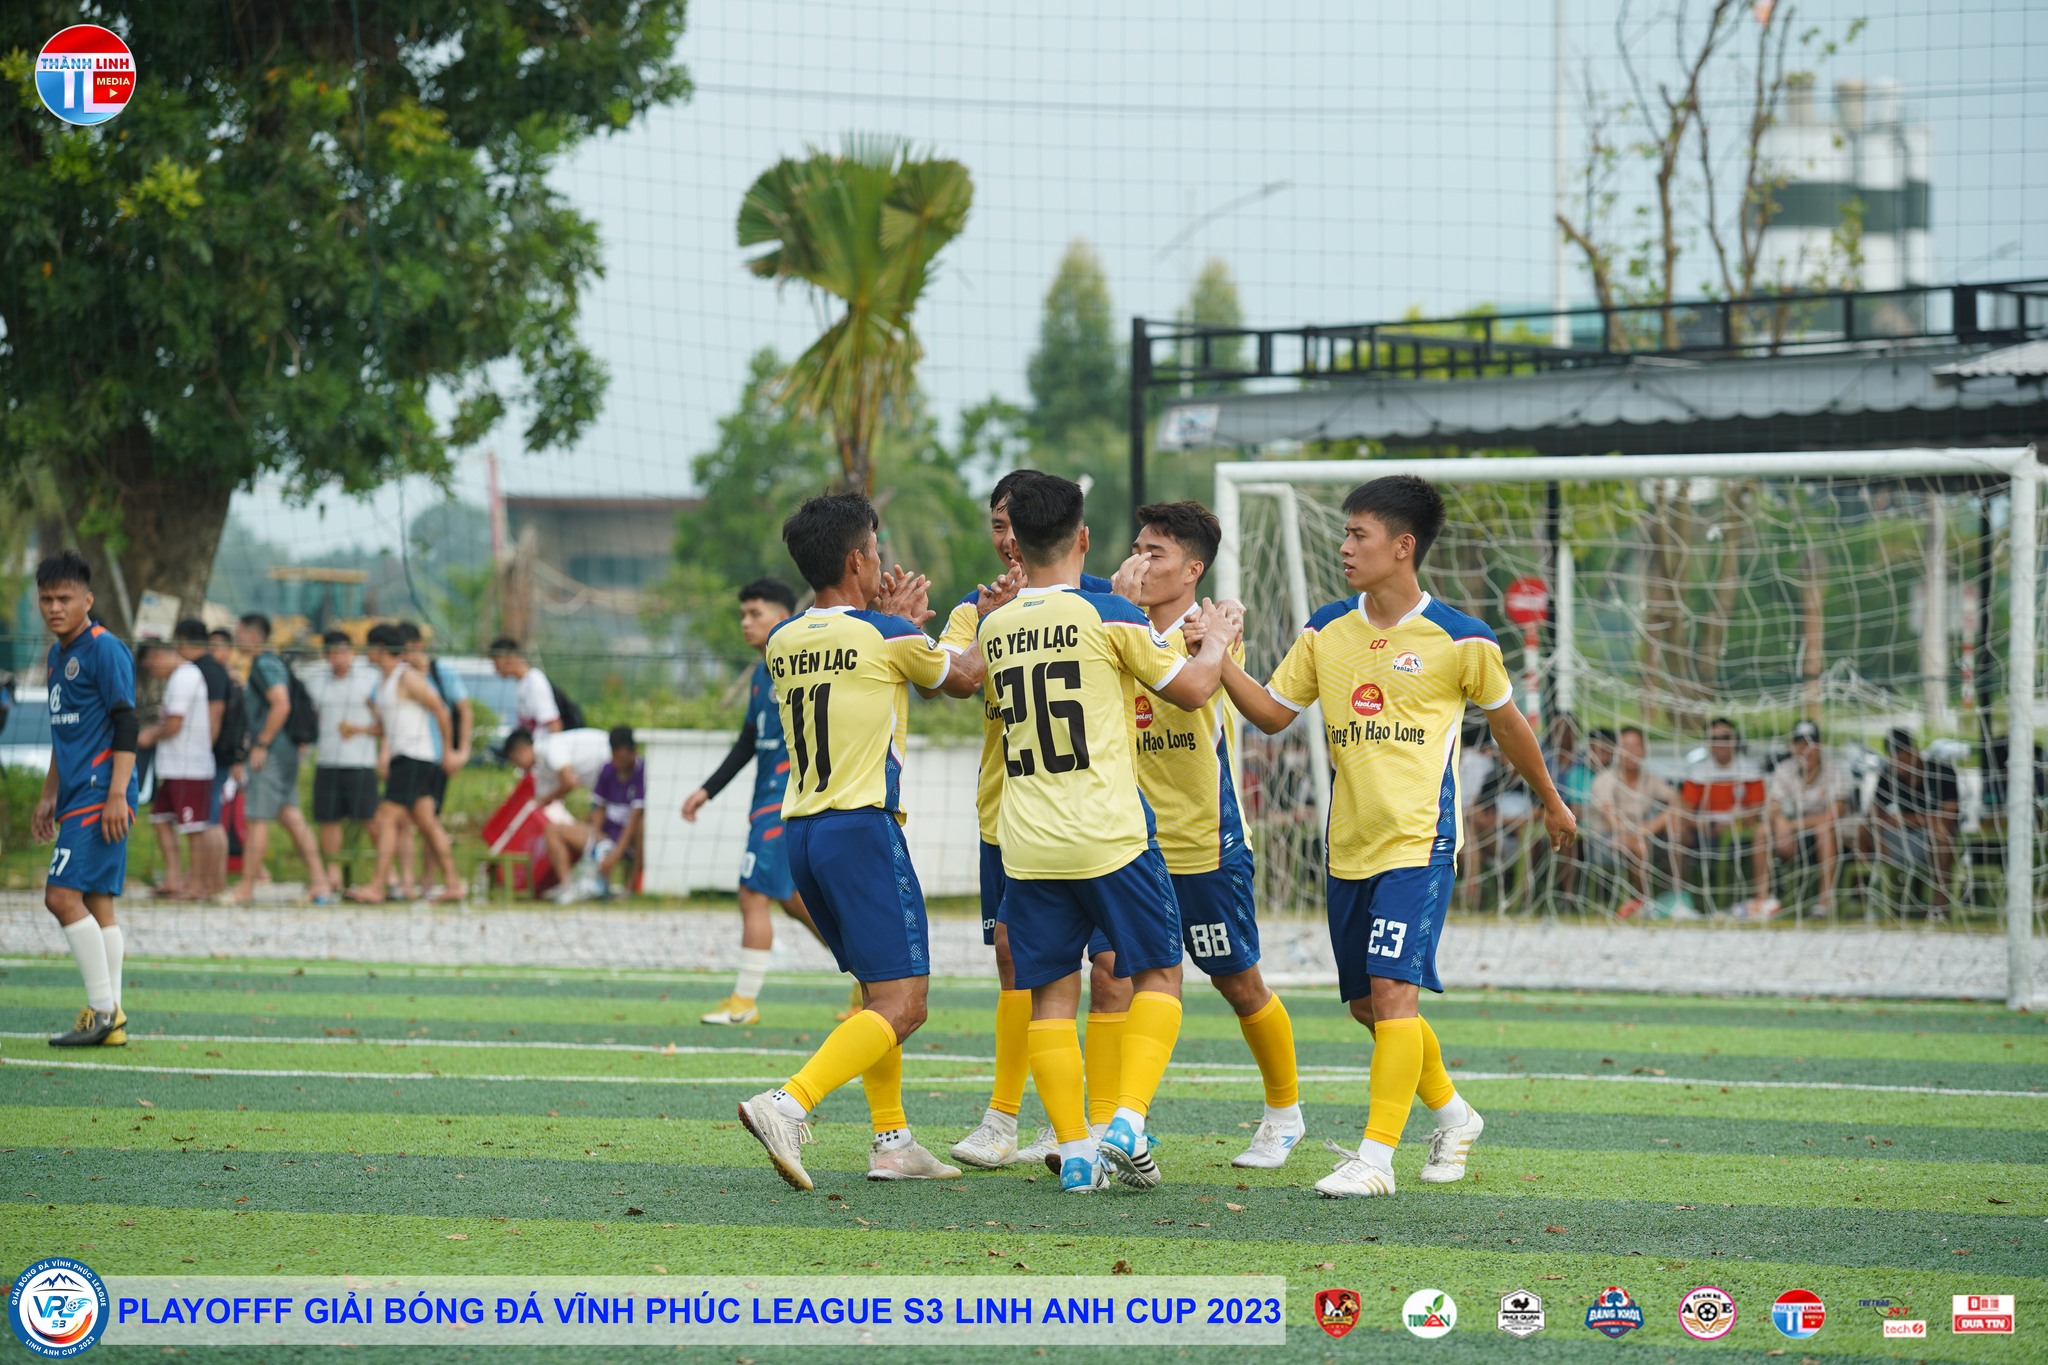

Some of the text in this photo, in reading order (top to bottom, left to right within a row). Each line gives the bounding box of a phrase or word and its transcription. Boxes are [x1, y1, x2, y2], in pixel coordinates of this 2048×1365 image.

[789, 649, 820, 676] YÊN
[823, 648, 858, 675] LẠC
[985, 624, 1078, 663] FC YÊN LẠC
[993, 660, 1090, 777] 26
[1327, 721, 1425, 747] ông Ty Hạo Long
[786, 682, 831, 794] 11
[1143, 731, 1164, 755] Hạo
[1166, 729, 1197, 751] Long
[1190, 922, 1232, 958] 88
[1368, 918, 1408, 958] 23
